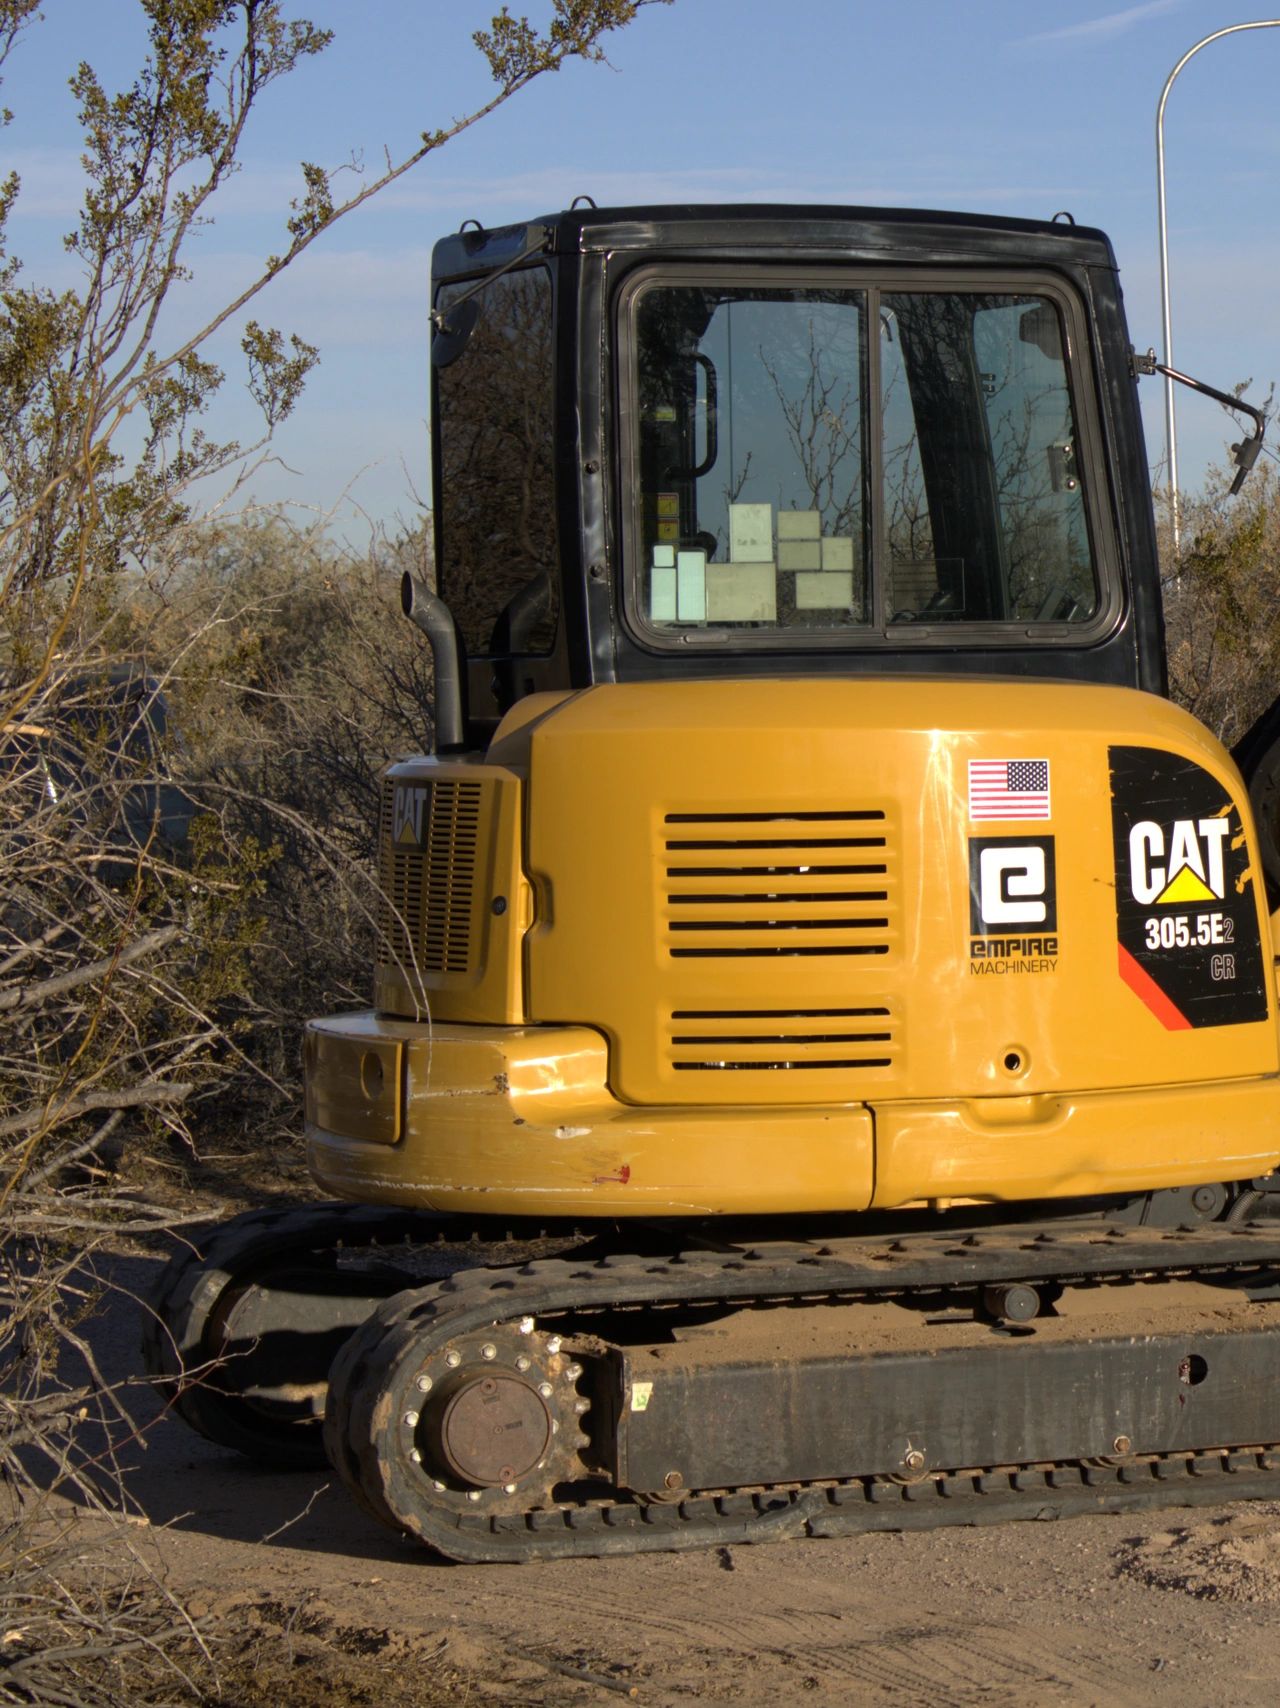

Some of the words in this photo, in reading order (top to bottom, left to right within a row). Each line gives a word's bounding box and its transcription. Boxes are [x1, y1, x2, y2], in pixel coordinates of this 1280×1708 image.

[394, 787, 428, 845] CAT
[1129, 818, 1229, 905] CAT
[970, 959, 1058, 976] MACHINERY
[1210, 953, 1236, 981] CR
